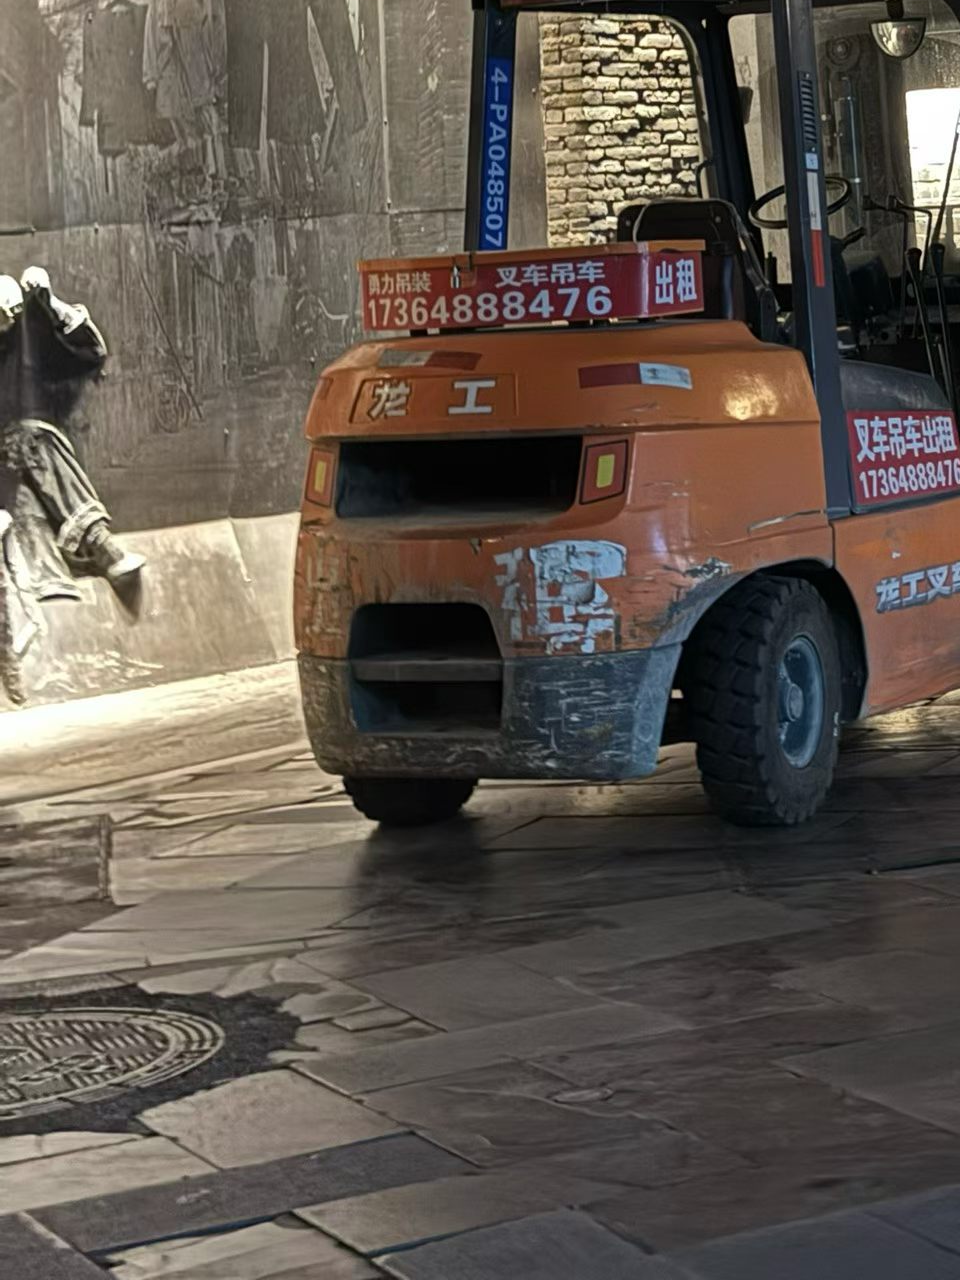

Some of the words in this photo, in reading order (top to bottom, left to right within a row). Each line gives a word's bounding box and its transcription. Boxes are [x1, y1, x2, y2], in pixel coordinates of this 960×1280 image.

[484, 67, 509, 248] 4-PA048507
[367, 271, 432, 297] 勇力吊装
[495, 260, 606, 289] 叉车吊车
[654, 258, 698, 306] 出租
[367, 285, 613, 328] 17364888476
[853, 415, 958, 463] 叉车吊车出租
